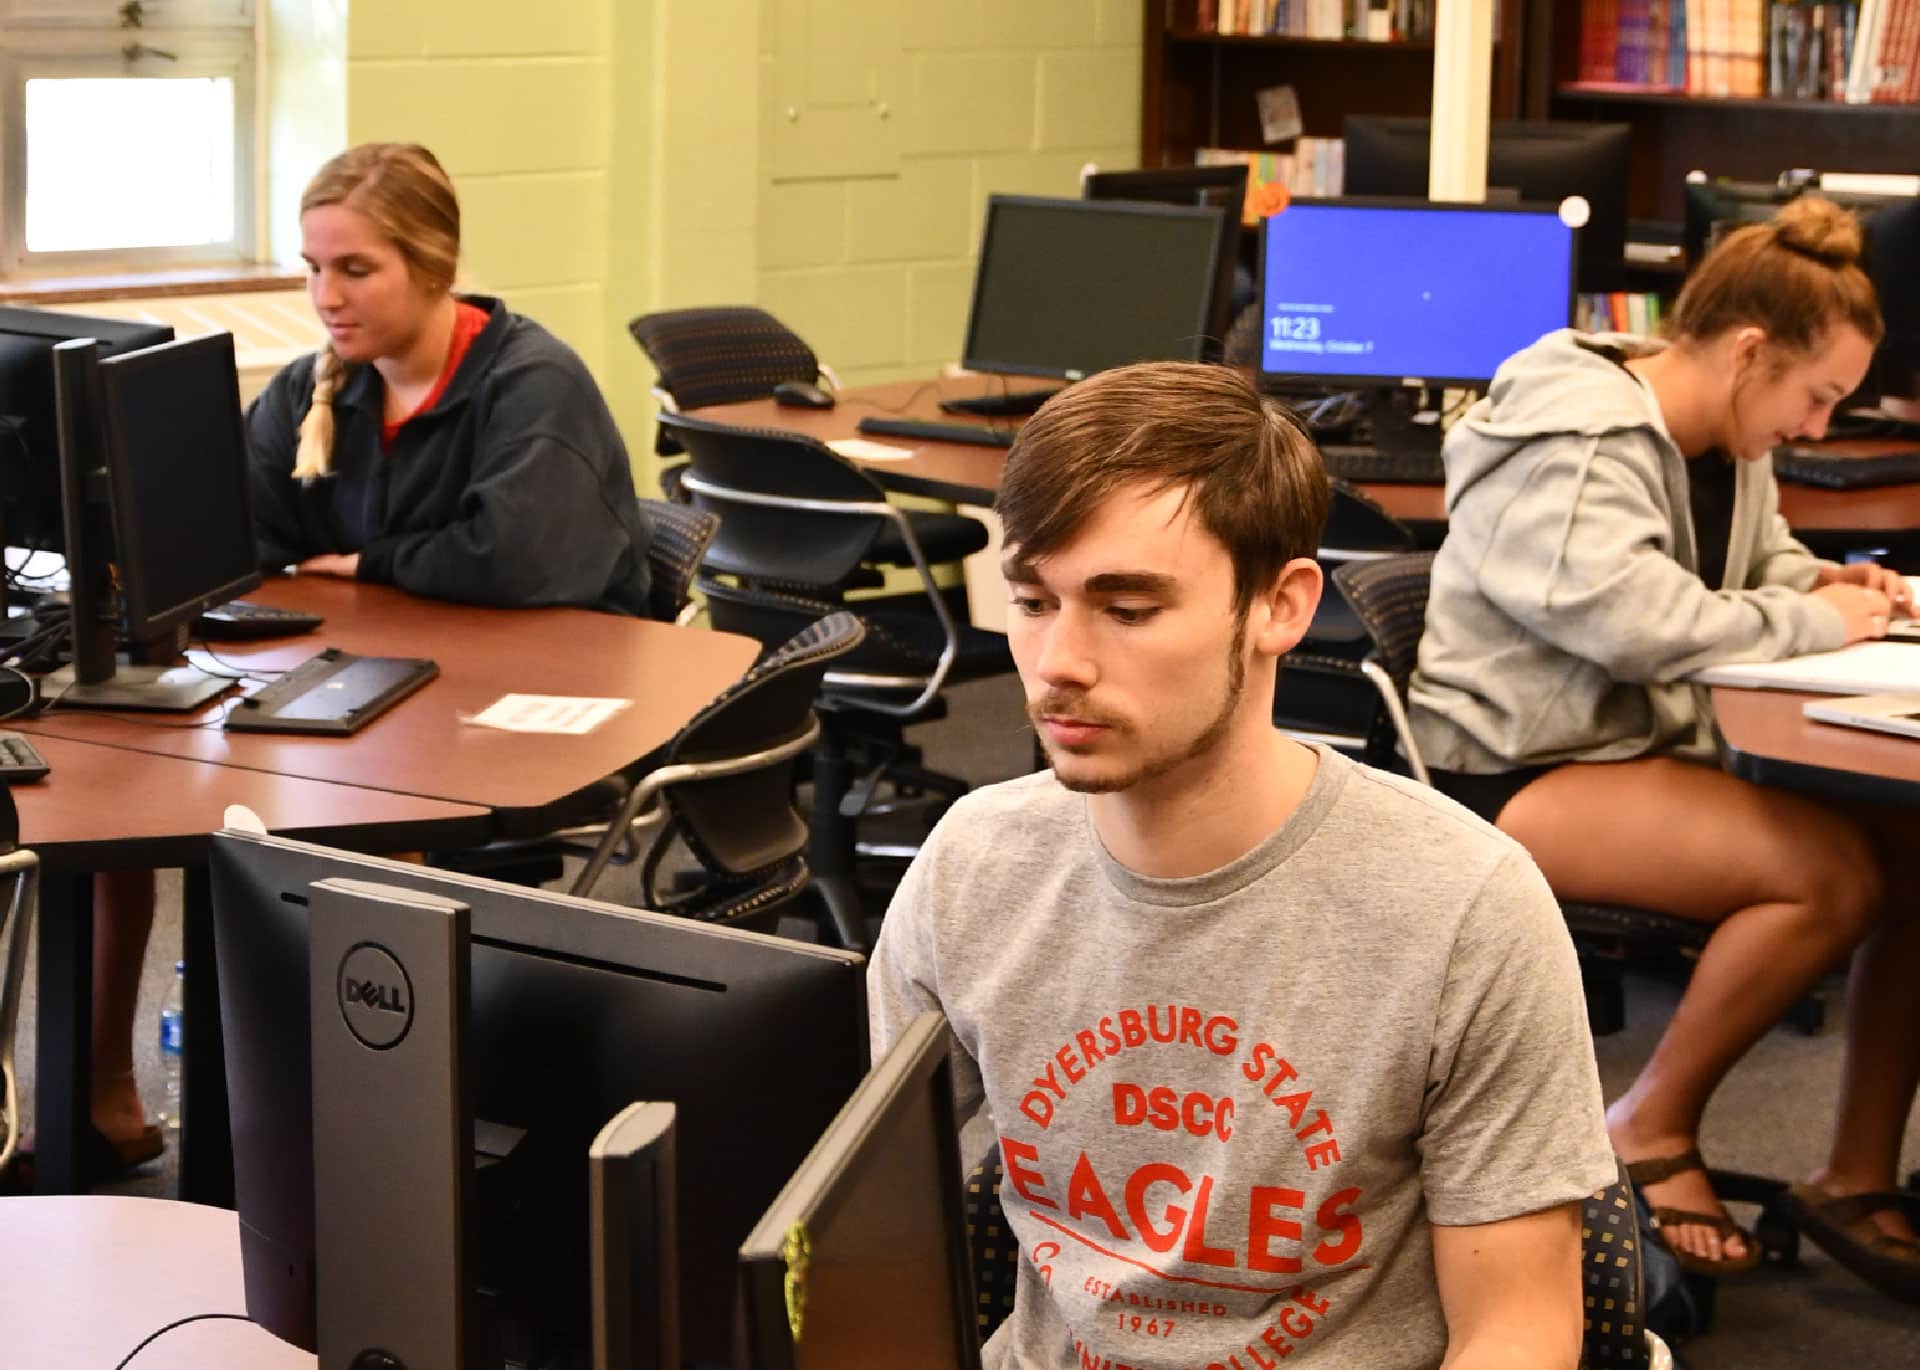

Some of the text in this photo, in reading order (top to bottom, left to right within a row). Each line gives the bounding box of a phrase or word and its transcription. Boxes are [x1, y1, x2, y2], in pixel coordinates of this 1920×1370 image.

[345, 977, 405, 1013] DELL
[1018, 1003, 1342, 1172] DYERSBURG STATE
[1111, 1081, 1236, 1144] DSCC
[999, 1135, 1364, 1275] EAGLES
[1083, 1275, 1227, 1317] ESTABLISHED
[1118, 1313, 1176, 1337] 1967
